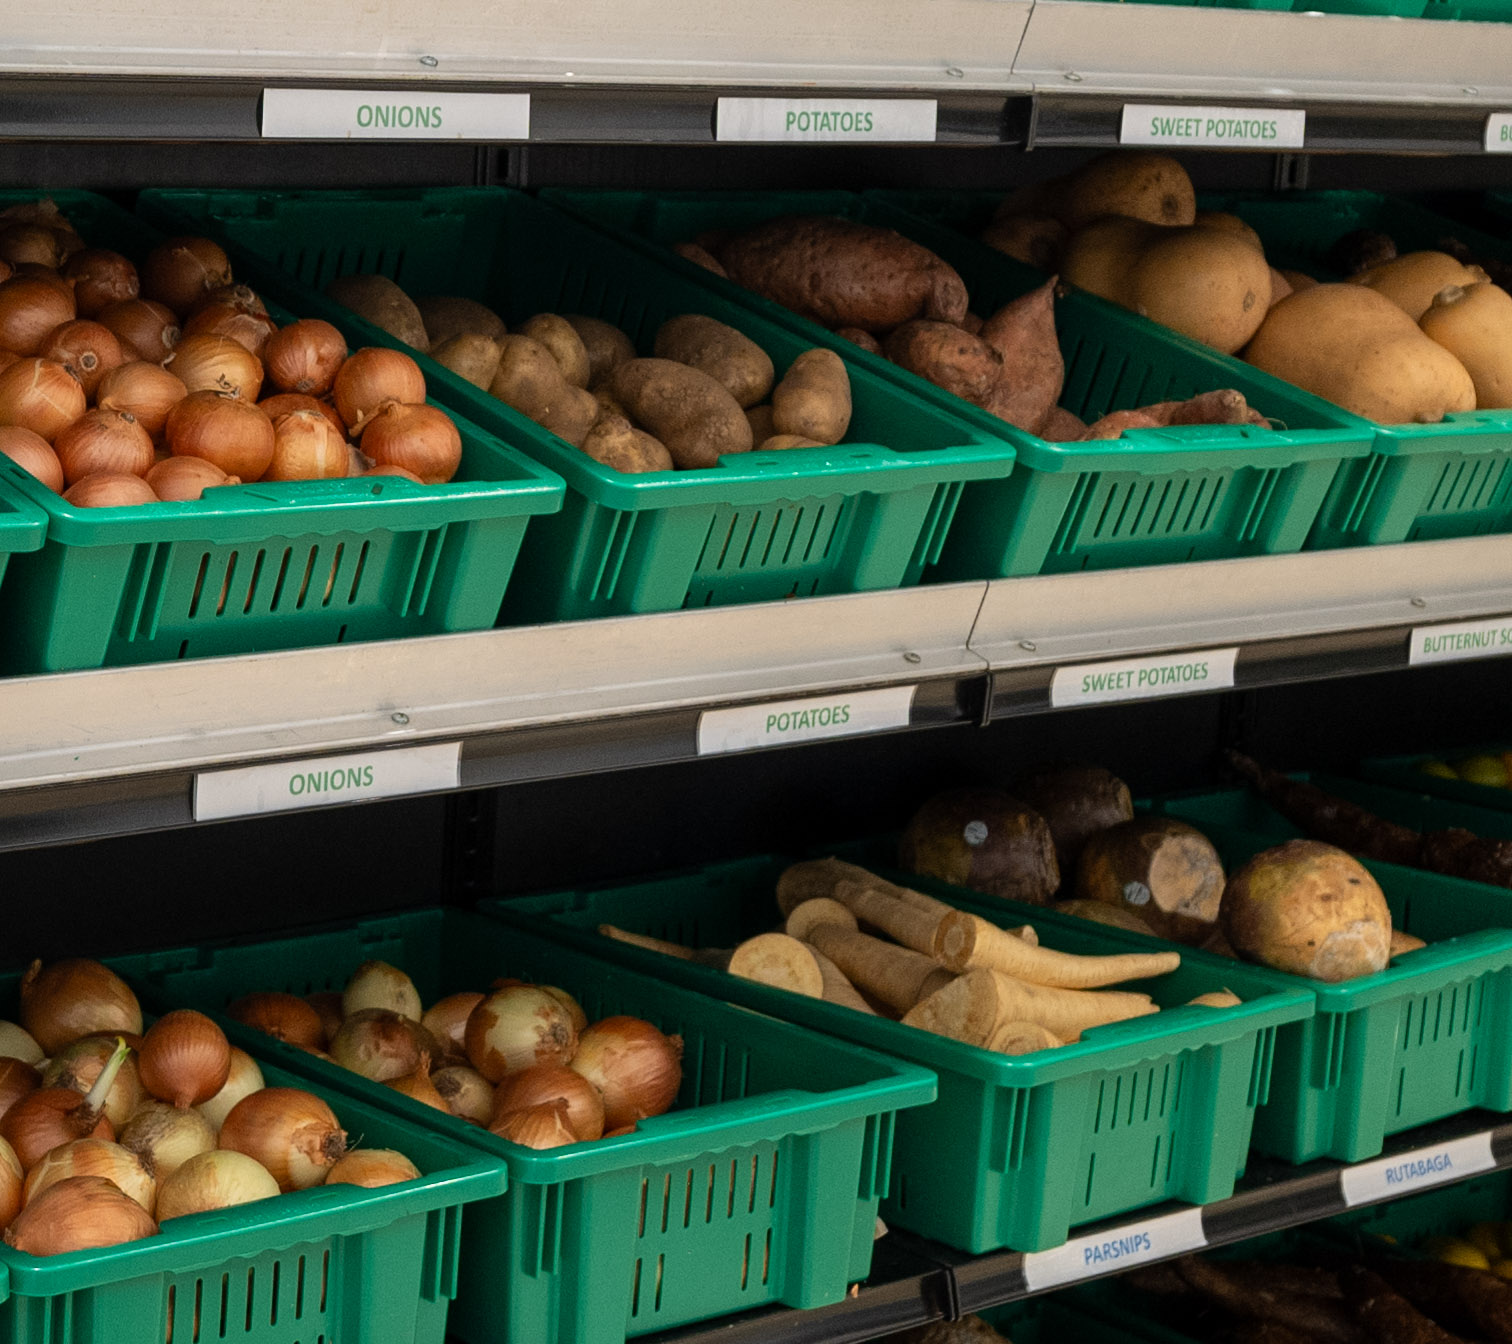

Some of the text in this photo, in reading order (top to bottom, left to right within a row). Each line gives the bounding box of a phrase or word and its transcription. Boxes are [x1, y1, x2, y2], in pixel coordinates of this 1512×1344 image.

[355, 103, 443, 131] ONIONS
[784, 110, 874, 134] POTATOES
[1150, 116, 1278, 140] SWEET POTATOES
[1423, 629, 1498, 653] BUTTERNUT
[1081, 661, 1209, 693] SWEET POTATOES
[765, 704, 851, 734] POTATOES
[288, 765, 374, 796] ONIONS
[1384, 1153, 1454, 1186] RUTABAGA
[1083, 1232, 1152, 1266] PARSNIPS
